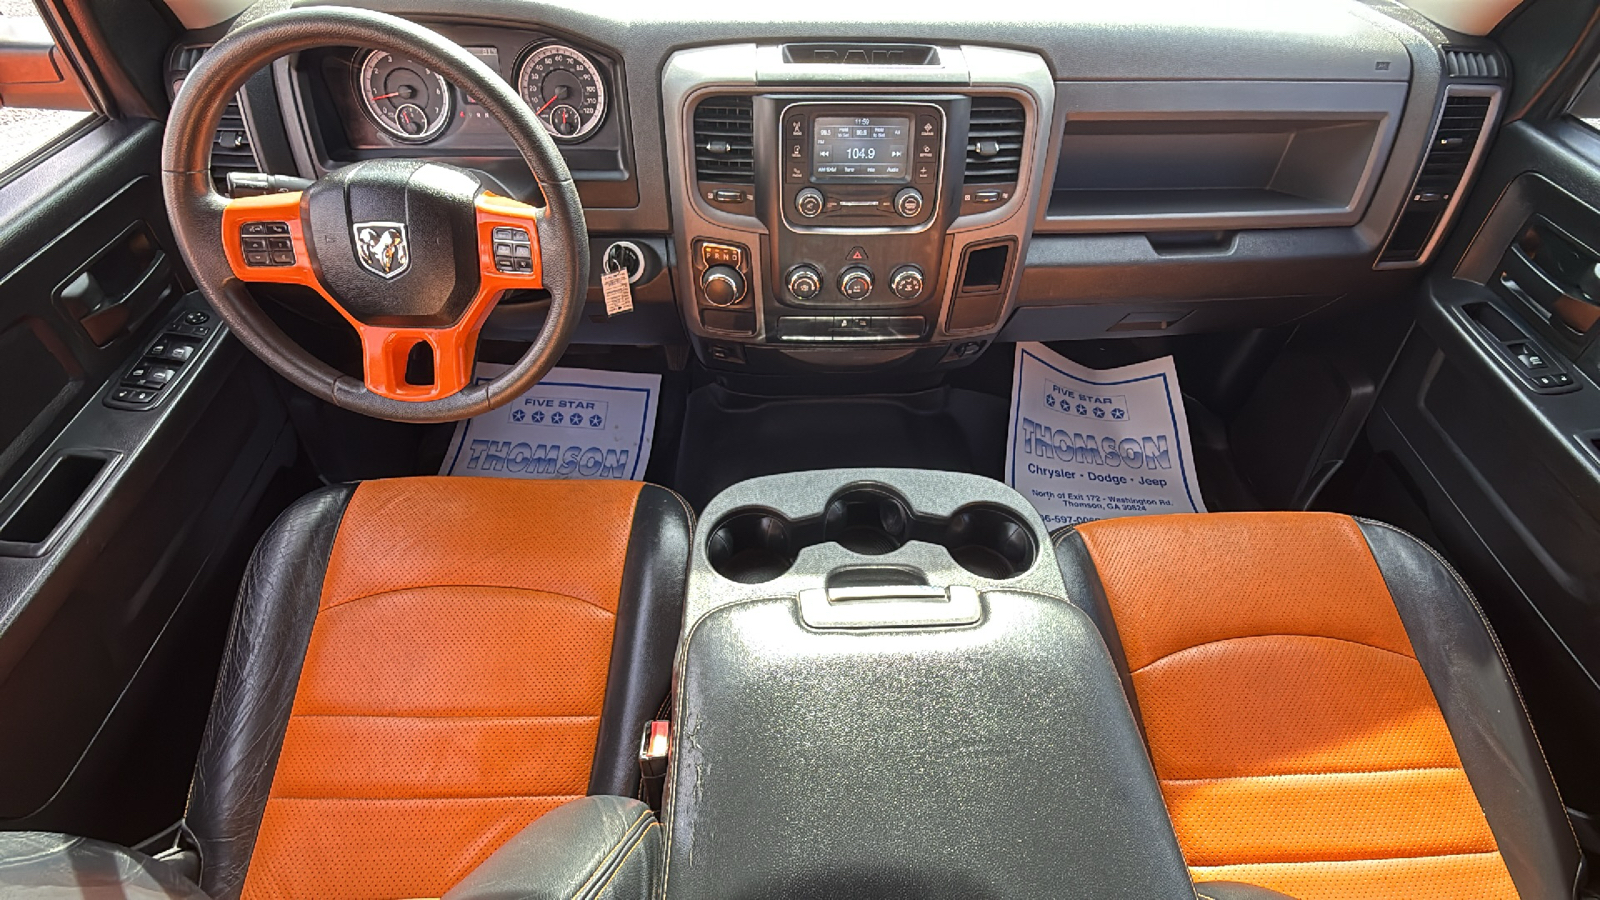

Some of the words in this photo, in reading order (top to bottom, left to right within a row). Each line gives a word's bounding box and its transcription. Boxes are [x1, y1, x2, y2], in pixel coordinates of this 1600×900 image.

[846, 148, 876, 159] 104.9
[1052, 384, 1075, 399] FIVE
[1078, 393, 1113, 404] STAR
[524, 398, 554, 408] FIVE
[558, 400, 596, 410] STAR
[1022, 417, 1172, 470] THOMSON
[467, 439, 629, 479] THOMSON
[1027, 463, 1076, 480] Chrysler
[1088, 471, 1128, 485] Dodge
[1138, 476, 1168, 488] Jeep
[1031, 489, 1055, 499] North
[1107, 496, 1156, 507] Washington
[1062, 500, 1106, 511] Thomson,
